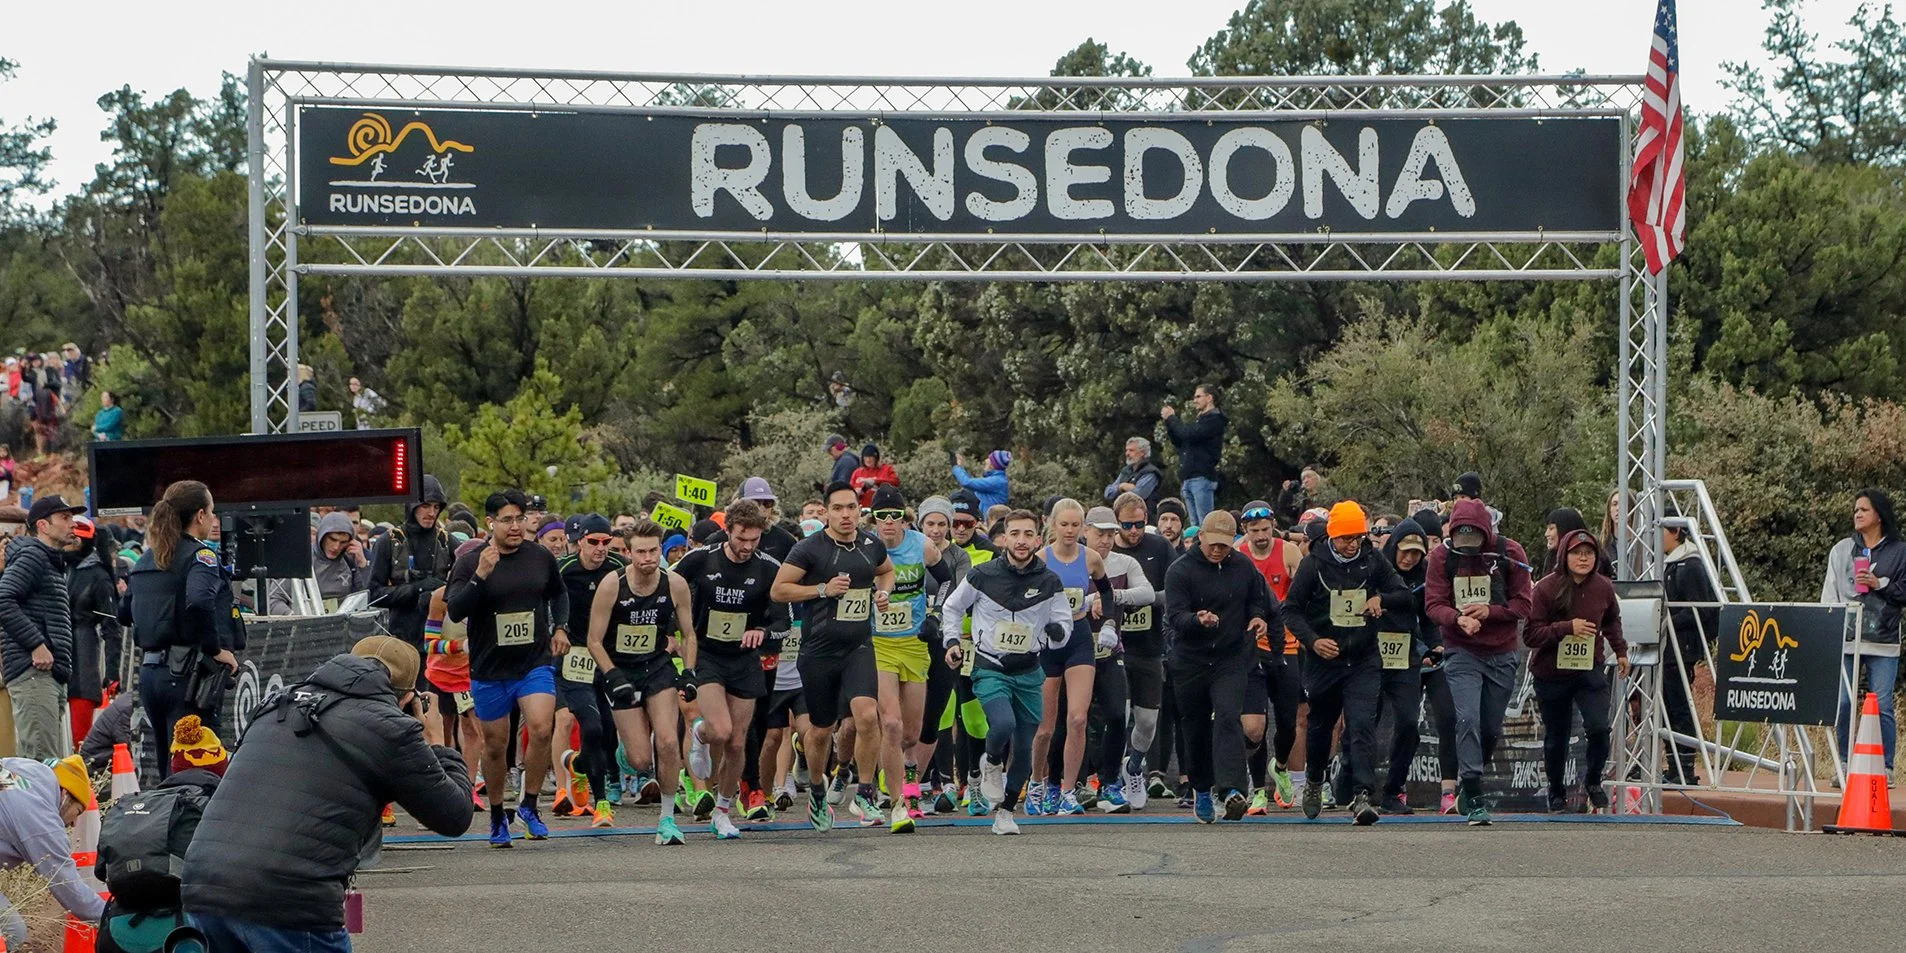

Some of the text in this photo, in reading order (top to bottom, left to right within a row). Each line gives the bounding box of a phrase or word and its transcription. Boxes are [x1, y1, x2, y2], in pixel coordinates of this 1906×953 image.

[691, 123, 1476, 221] RUNSEDONA
[329, 193, 477, 215] RUNSEDONA
[299, 420, 336, 431] PEED
[682, 485, 708, 501] 1:40
[657, 513, 683, 529] 1:50
[895, 568, 919, 581] AN
[715, 586, 746, 598] BLANK
[1460, 586, 1486, 599] 1446
[715, 595, 743, 605] SLATE
[845, 599, 867, 614] 728
[1067, 597, 1077, 608] 9
[1345, 600, 1353, 612] 3
[630, 609, 659, 618] BLANK
[881, 612, 906, 626] 232
[504, 623, 529, 638] 205
[722, 622, 731, 635] 2
[624, 634, 649, 647] 372
[1000, 632, 1026, 646] 1437
[1382, 642, 1403, 655] 397
[1564, 642, 1588, 656] 396
[570, 655, 594, 671] 640
[1727, 689, 1796, 711] RUNSEDONA
